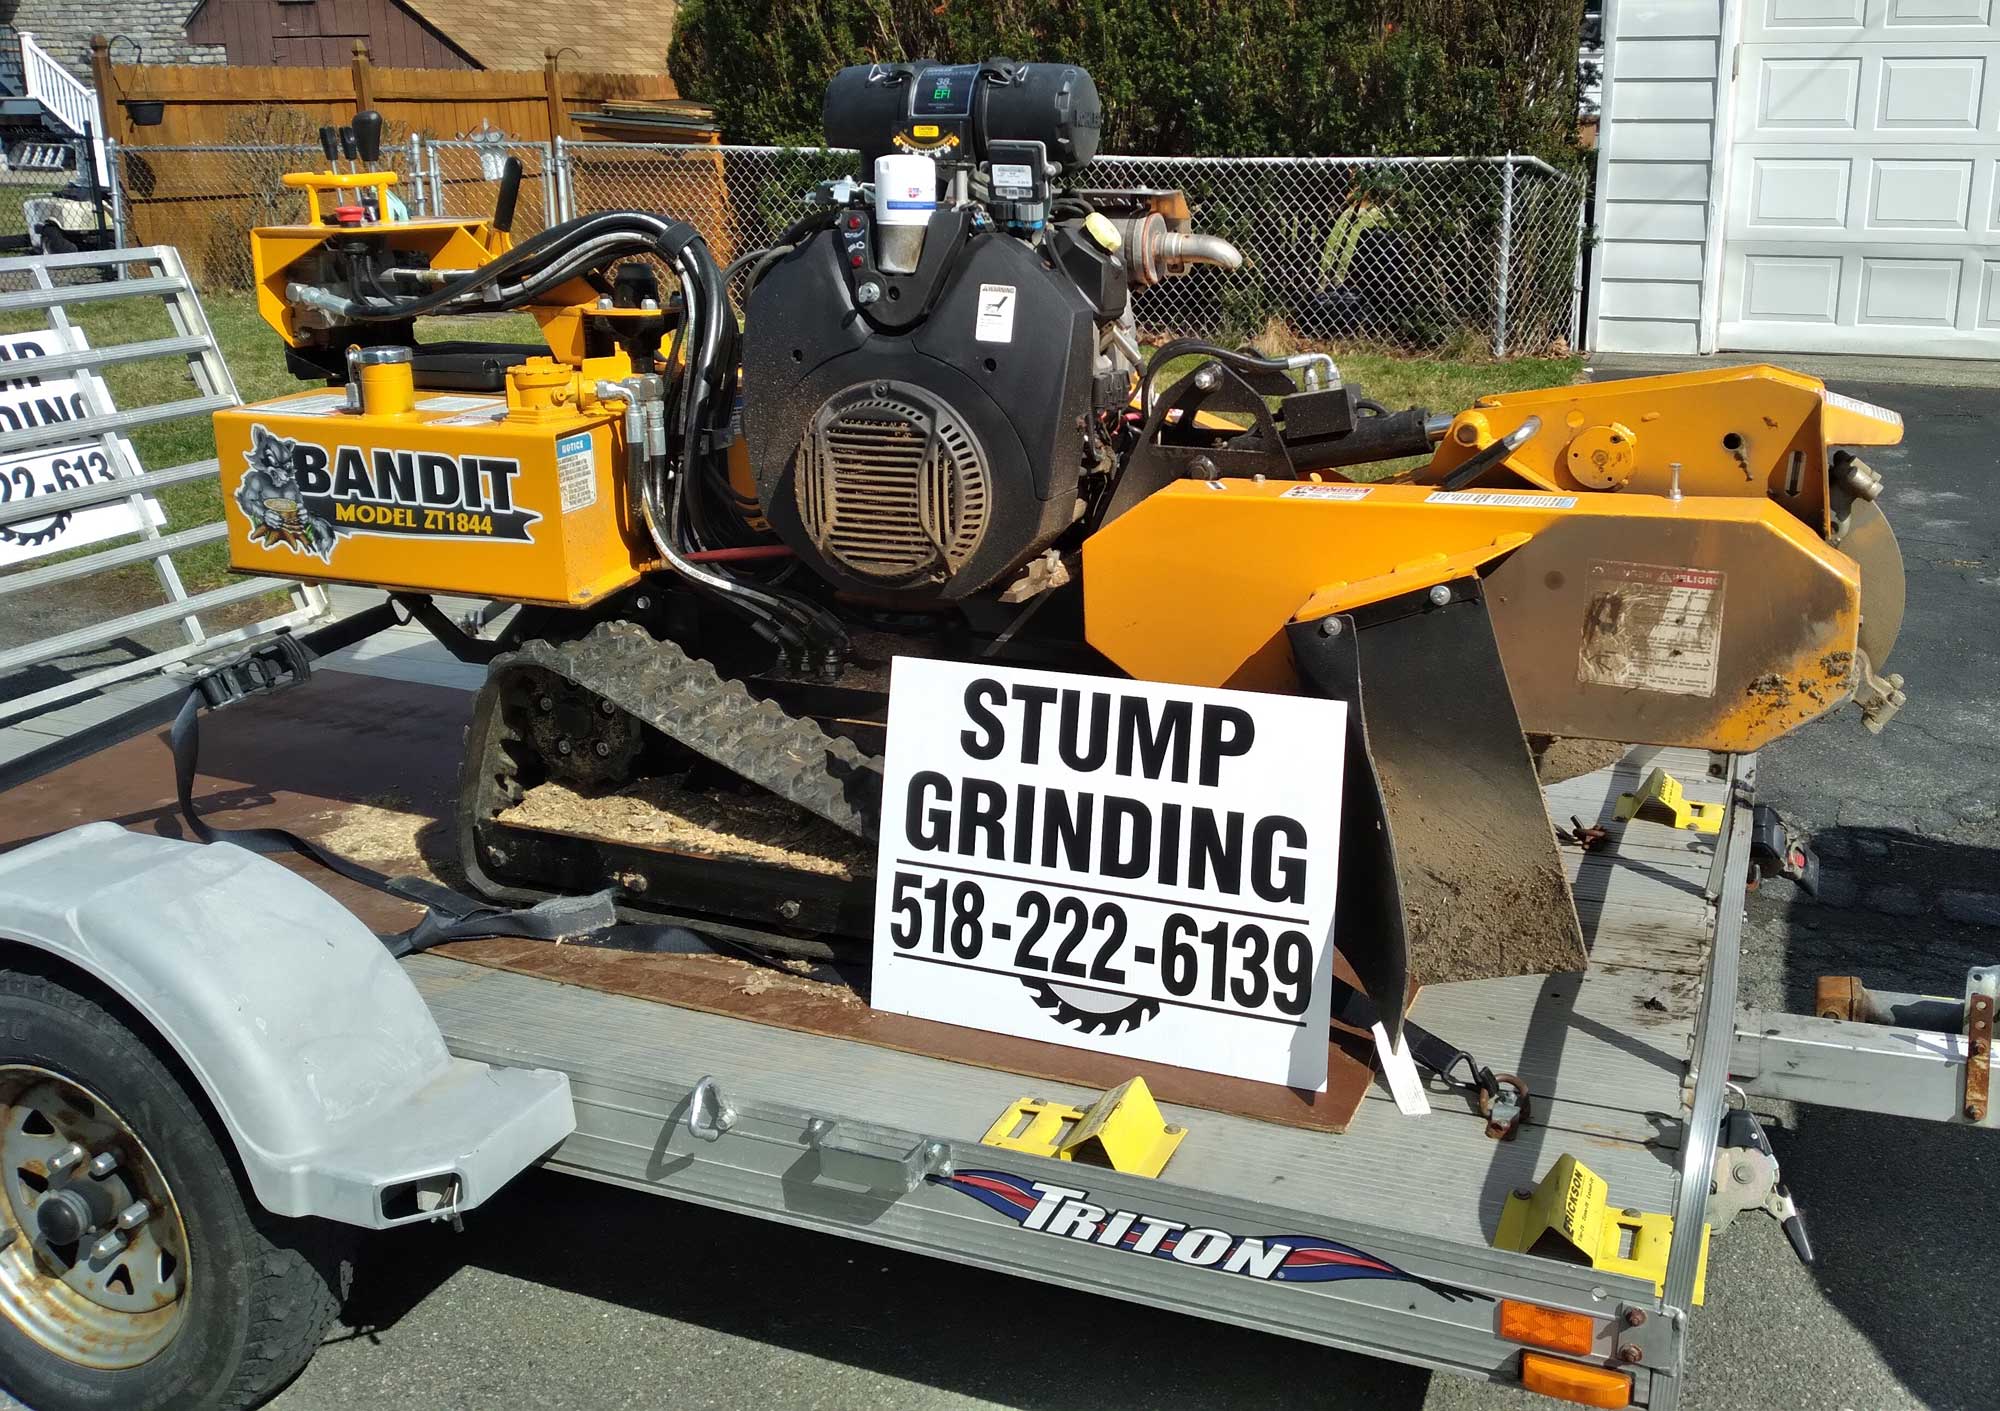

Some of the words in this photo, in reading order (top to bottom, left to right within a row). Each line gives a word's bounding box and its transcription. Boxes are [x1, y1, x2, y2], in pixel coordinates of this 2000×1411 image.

[934, 89, 951, 99] EFI
[295, 444, 518, 512] BANDIT
[335, 503, 418, 529] MODEL
[423, 509, 494, 535] ZT1844
[960, 678, 1256, 788] STUMP
[904, 770, 1308, 905] GRINDING
[890, 871, 1313, 1016] 518-222-6139
[1021, 1182, 1293, 1280] TRITON
[1563, 1169, 1583, 1238] ERICKSON
